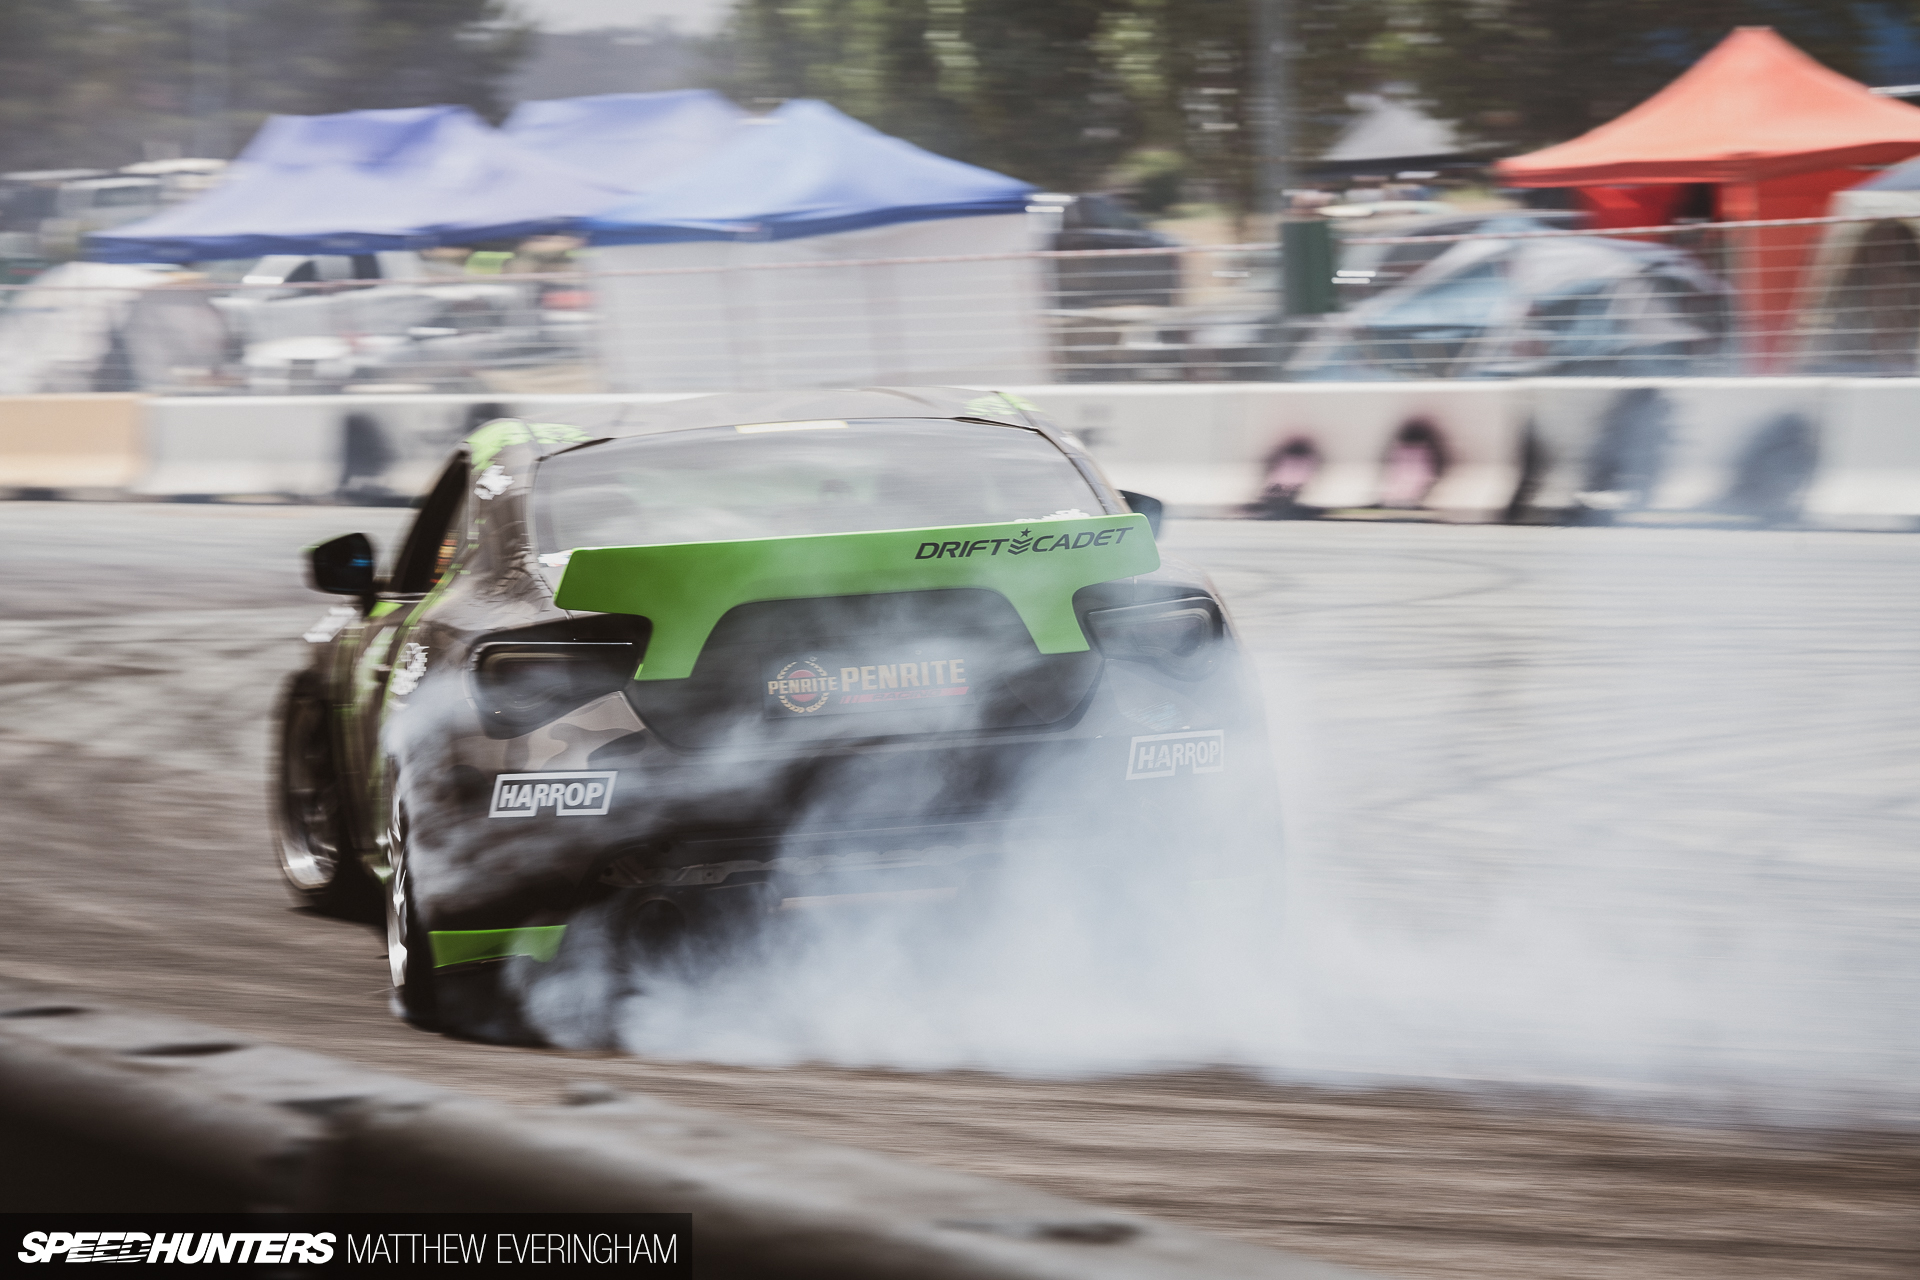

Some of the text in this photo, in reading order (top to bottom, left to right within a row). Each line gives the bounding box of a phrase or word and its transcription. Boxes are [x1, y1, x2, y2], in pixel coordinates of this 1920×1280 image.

[914, 526, 1134, 560] DRIFT CADET
[767, 676, 839, 695] PENRITE
[840, 658, 967, 692] PENRITE
[1137, 740, 1220, 770] HARROP
[498, 782, 605, 809] HARROP
